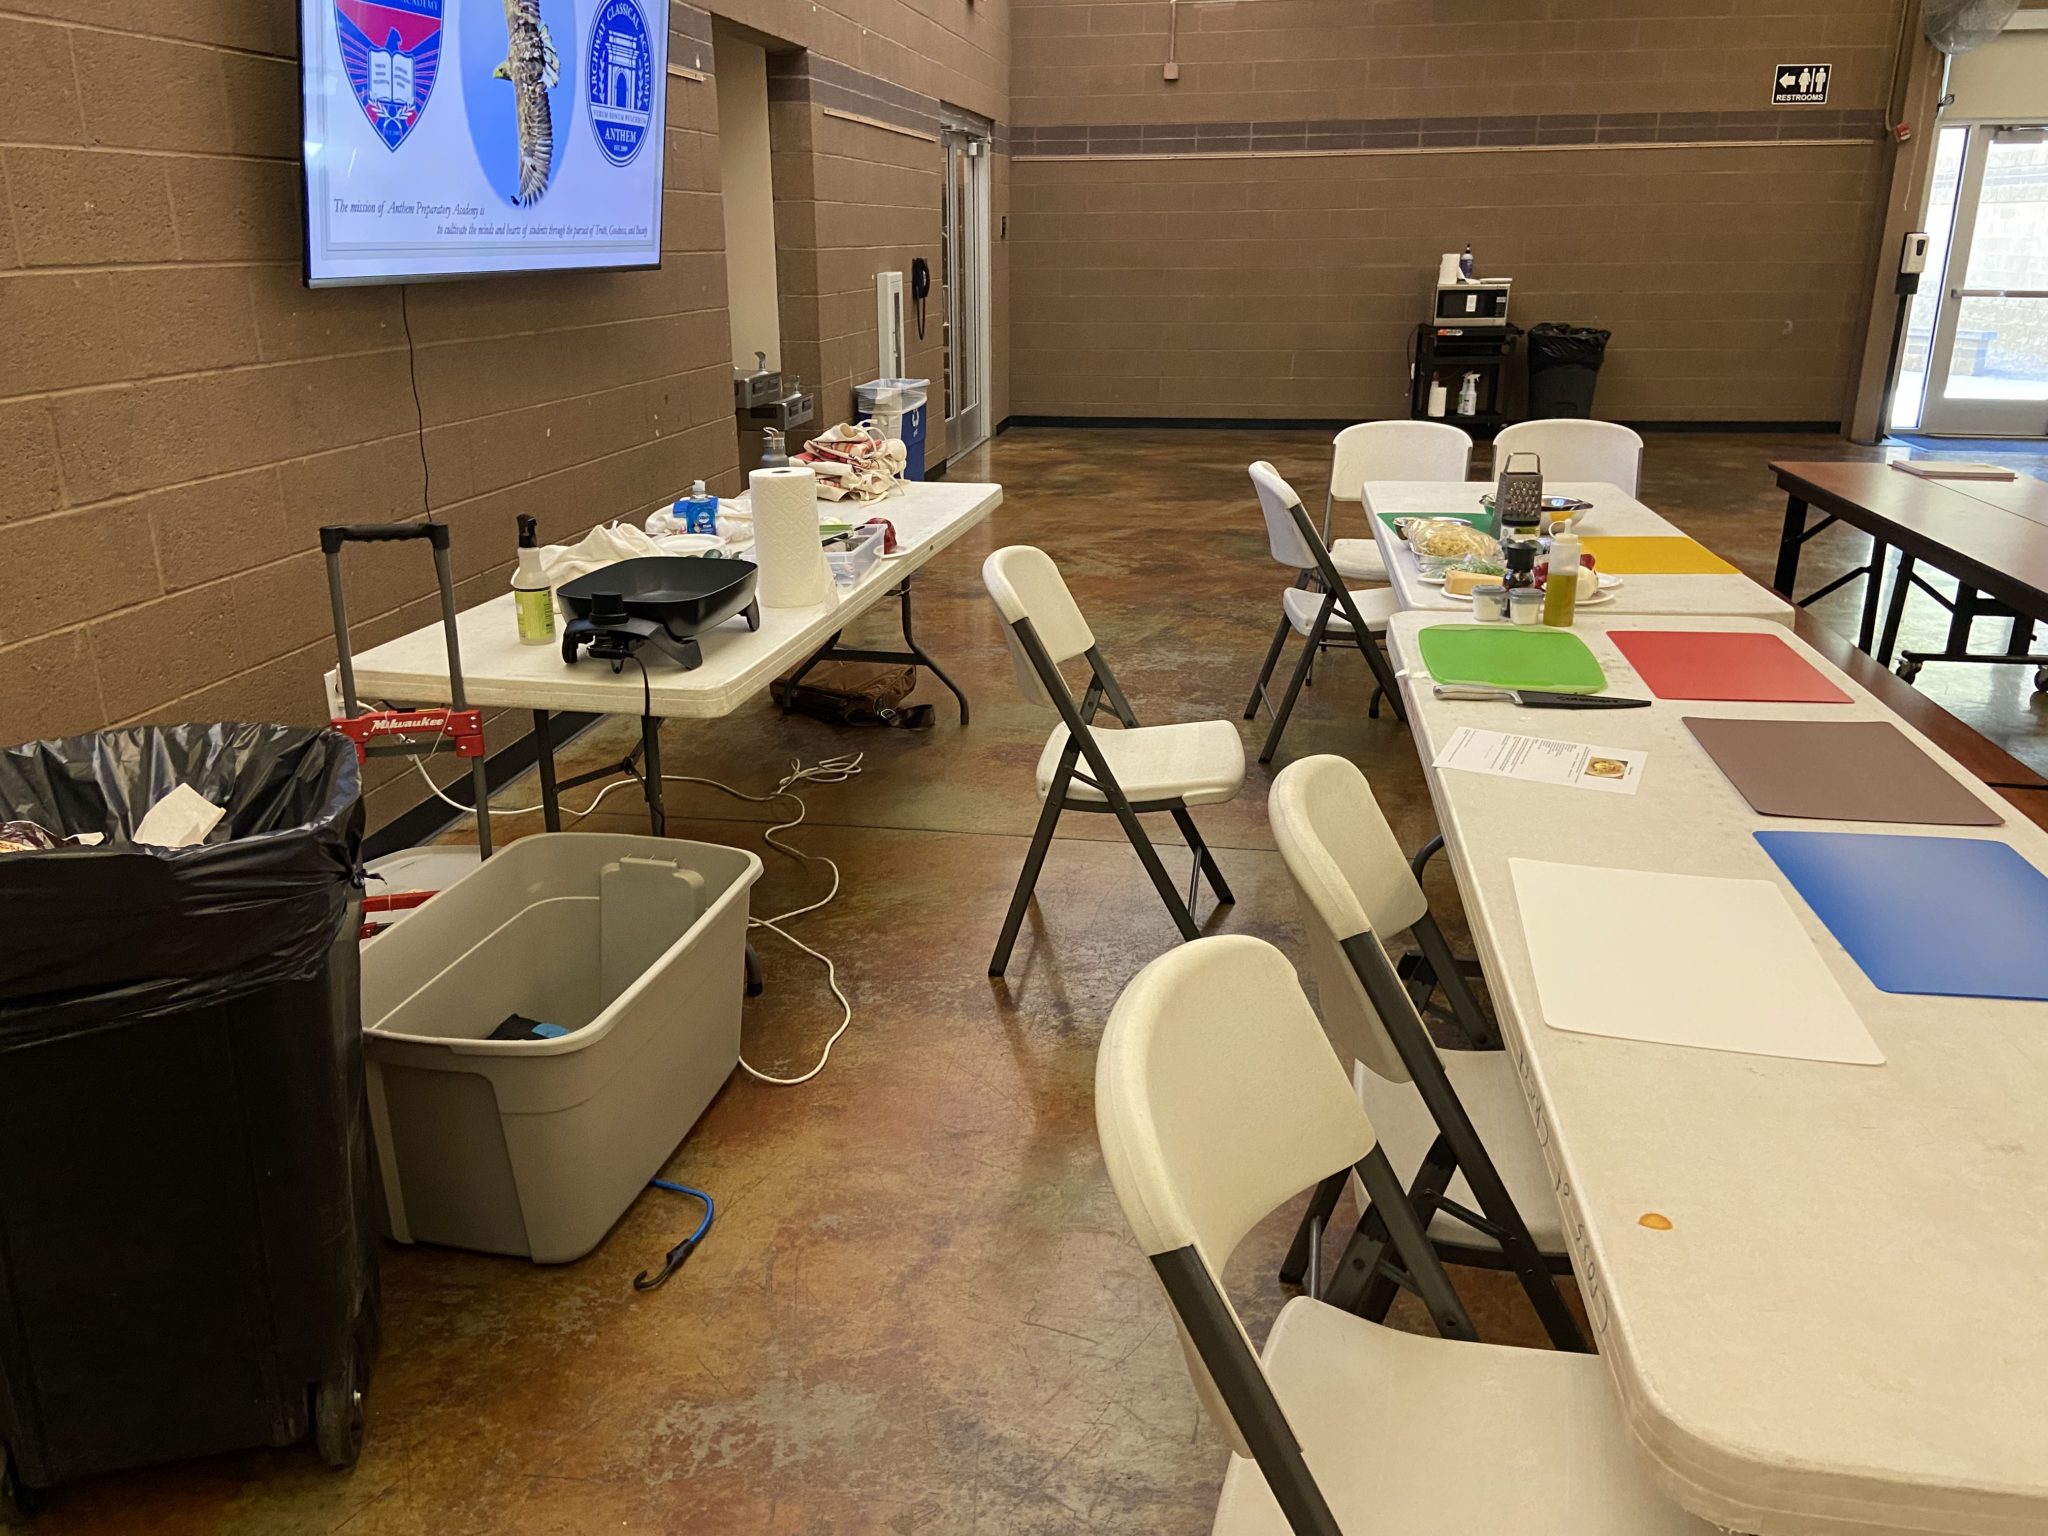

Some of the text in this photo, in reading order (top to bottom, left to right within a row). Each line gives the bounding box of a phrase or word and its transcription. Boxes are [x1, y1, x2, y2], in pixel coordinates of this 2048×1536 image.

[591, 2, 650, 106] ARCHWAY CLASSICAL ACADEMY
[604, 127, 637, 143] ANTHEM
[334, 198, 348, 213] The
[350, 200, 376, 213] mission
[377, 200, 386, 218] of
[387, 201, 415, 214] Anthem
[416, 201, 451, 219] Preparatory
[452, 202, 478, 220] Academy
[436, 223, 443, 235] to
[444, 222, 468, 235] cultivate
[468, 222, 477, 235] the
[478, 222, 495, 235] minds
[495, 222, 506, 235] and
[507, 222, 521, 235] hearts
[522, 223, 529, 239] of
[548, 223, 565, 239] through
[371, 717, 444, 732] Milwaukee
